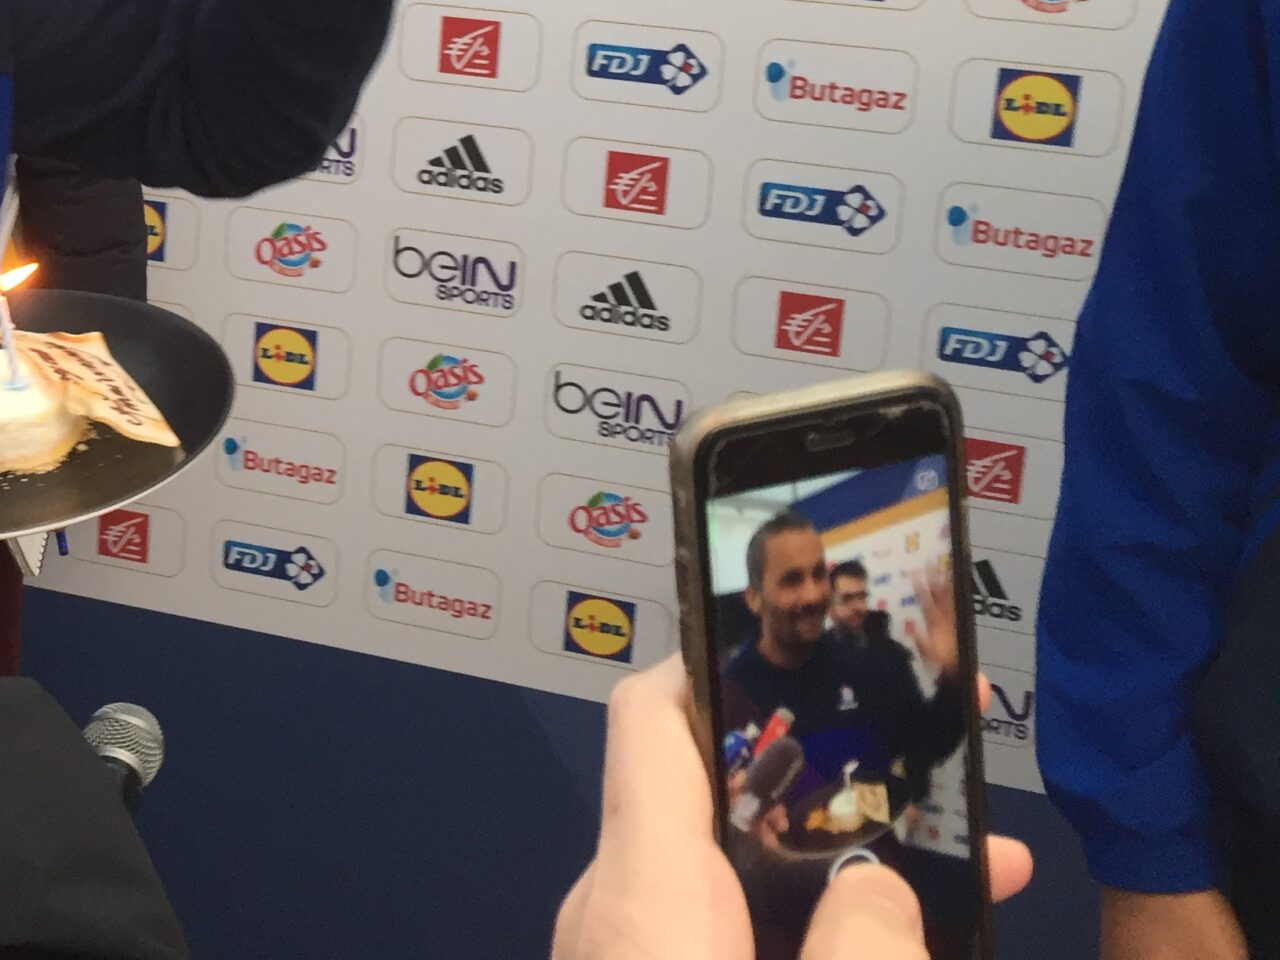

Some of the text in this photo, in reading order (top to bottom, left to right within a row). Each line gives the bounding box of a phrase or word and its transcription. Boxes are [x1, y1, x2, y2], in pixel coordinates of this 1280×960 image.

[589, 51, 651, 77] FDJ
[788, 75, 908, 113] Butagaz
[417, 166, 505, 195] adidas
[763, 189, 827, 218] FDJ
[254, 226, 328, 267] Oasis
[970, 220, 1093, 258] Butagaz
[435, 284, 515, 311] SPORTS
[580, 303, 671, 332] adidas
[941, 333, 1008, 362] FDJ
[408, 359, 485, 399] Oasis
[243, 450, 337, 485] Butagaz
[568, 496, 649, 533] Oasis
[227, 548, 278, 572] FDJ
[393, 582, 493, 620] Butagaz
